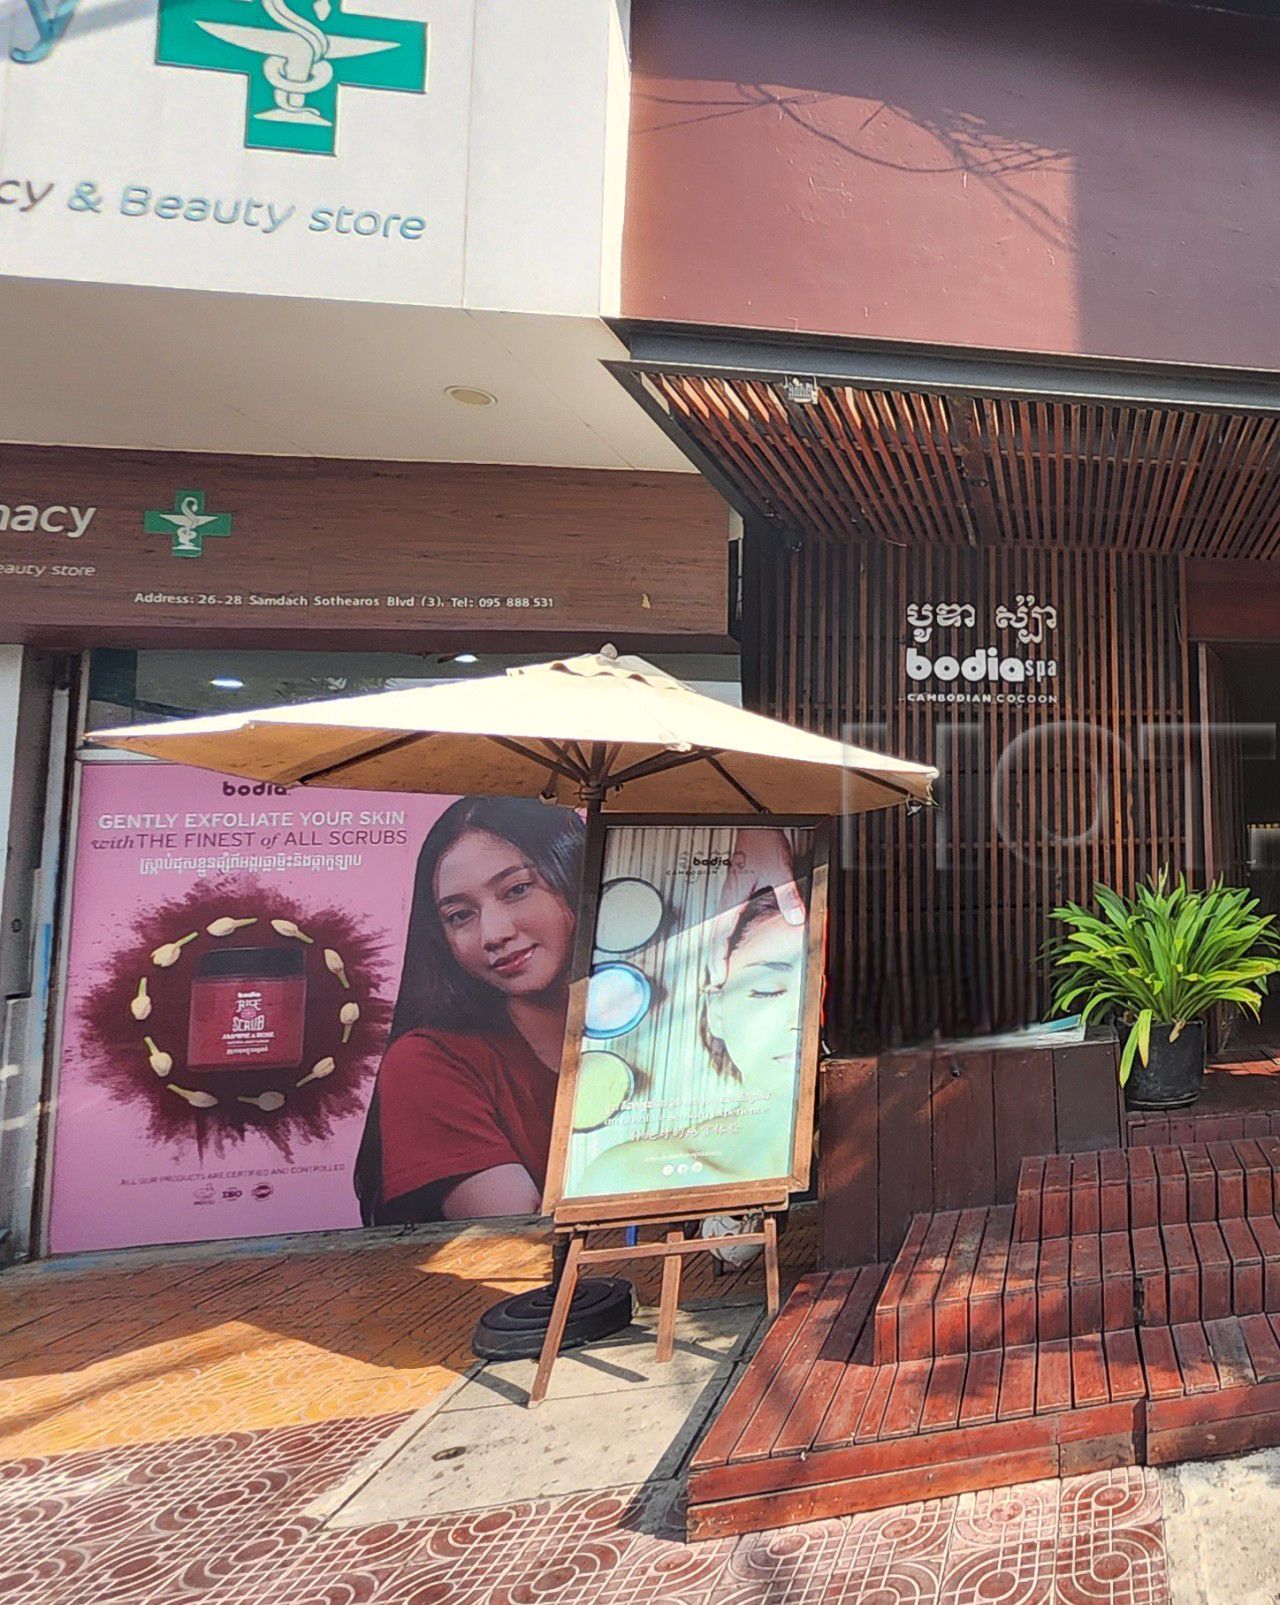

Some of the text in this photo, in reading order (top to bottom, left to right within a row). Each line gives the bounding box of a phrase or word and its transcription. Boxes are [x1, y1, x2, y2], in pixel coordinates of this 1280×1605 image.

[67, 181, 103, 214] &
[119, 184, 296, 234] Beauty
[308, 204, 428, 241] store
[50, 564, 96, 577] store
[134, 592, 195, 605] Address:
[198, 594, 243, 606] 26-28
[249, 594, 309, 607] Samdach
[313, 595, 380, 607] Sothearos
[386, 596, 415, 608] Blvd
[450, 597, 475, 608] Tel:
[478, 597, 501, 608] 095
[506, 597, 530, 608] 888
[533, 597, 554, 608] 531
[906, 692, 1059, 704] CAMBODIAN COCOON
[97, 810, 406, 830] GENTLY EXFOLIATE YOUR SKIN
[89, 830, 408, 851] with THE FINEST of ALL SCRUBS
[232, 1014, 265, 1032] SCRUB
[226, 1168, 269, 1179] CERTIFIED
[270, 1166, 289, 1176] AND
[291, 1163, 346, 1175] CONTROLLED
